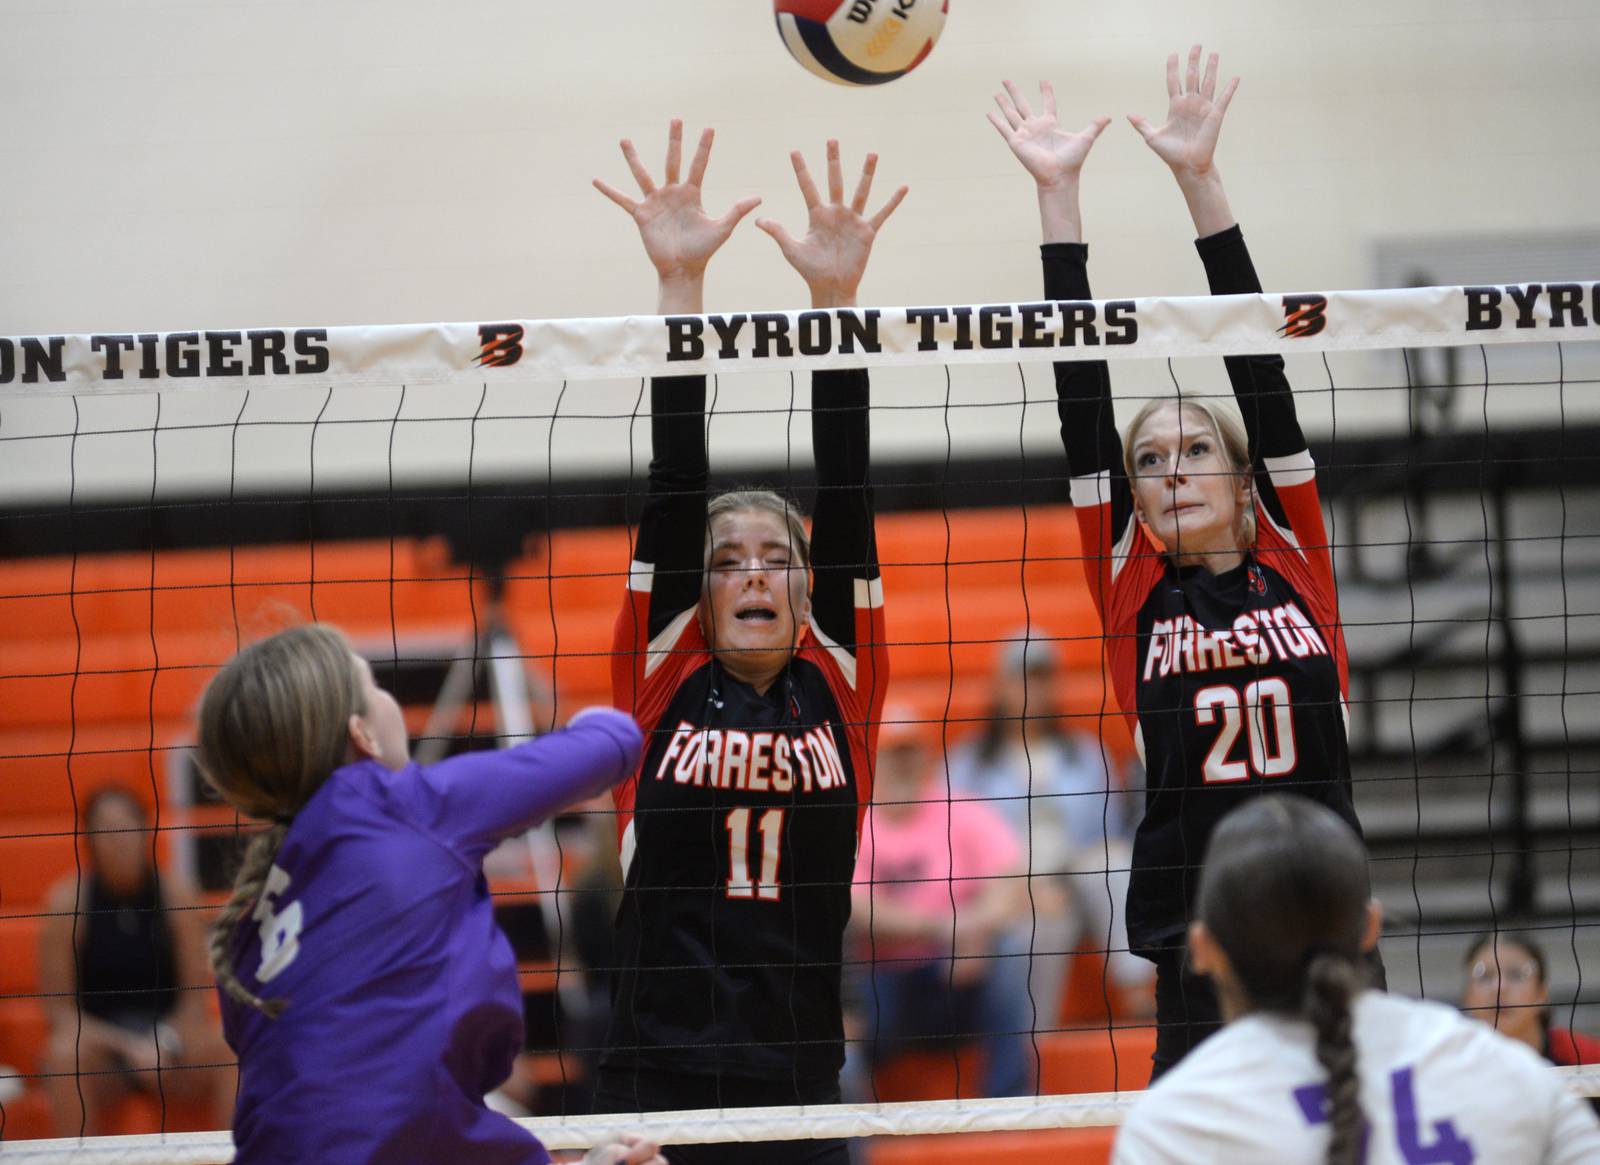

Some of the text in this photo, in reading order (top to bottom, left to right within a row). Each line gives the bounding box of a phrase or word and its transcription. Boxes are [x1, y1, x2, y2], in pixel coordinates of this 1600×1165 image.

[665, 300, 1138, 362] BYRON TIGERS
[1276, 293, 1328, 339] B
[1463, 283, 1600, 331] BYR
[91, 328, 329, 380] TIGERS
[475, 323, 524, 369] B
[1143, 600, 1329, 682] FORRESTON
[655, 719, 847, 793] FORRESTON
[1194, 676, 1298, 784] 20
[725, 807, 785, 901] 11
